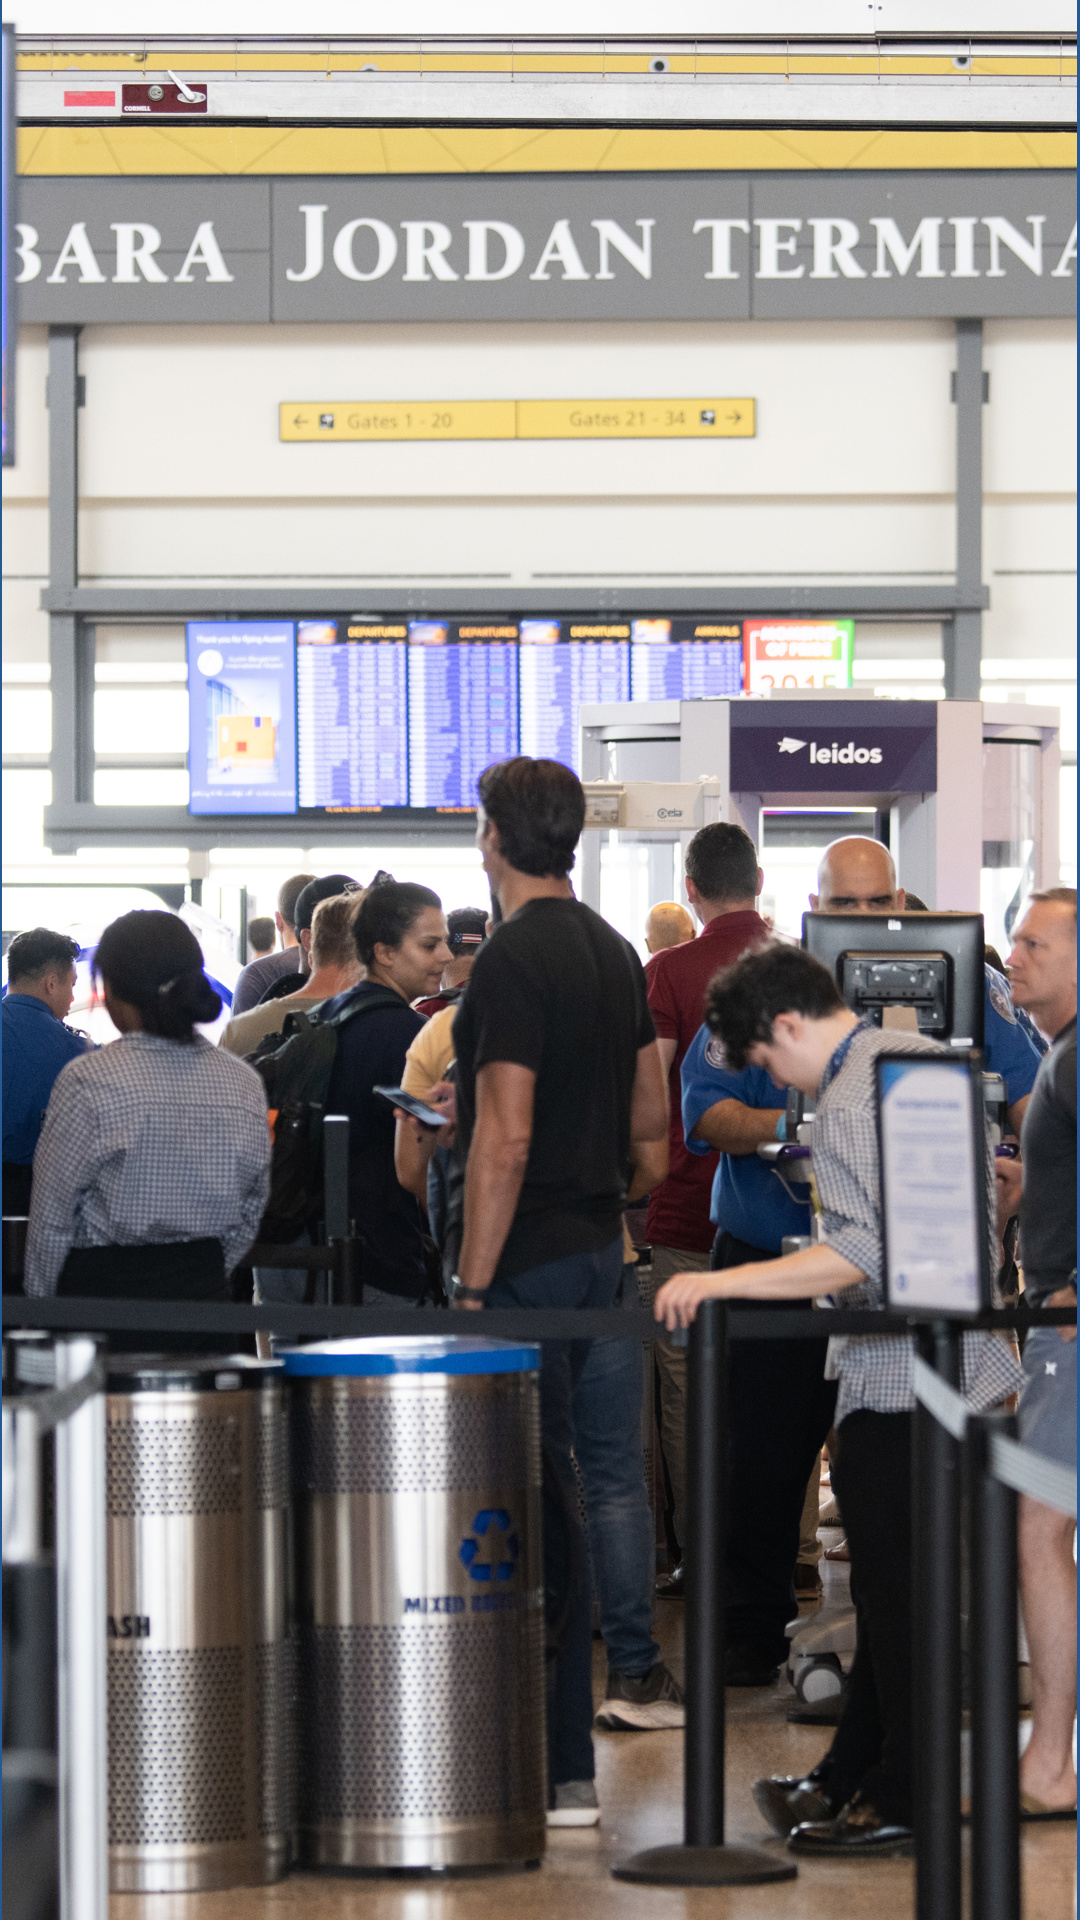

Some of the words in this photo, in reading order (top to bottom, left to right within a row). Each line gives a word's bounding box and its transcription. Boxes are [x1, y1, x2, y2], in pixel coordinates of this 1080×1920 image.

[286, 205, 655, 282] JORDAN
[347, 413, 397, 429] Gates
[405, 413, 412, 428] 1
[431, 413, 452, 428] 20
[569, 410, 619, 427] Gates
[625, 410, 646, 427] 21
[665, 409, 685, 426] 34
[347, 626, 407, 638] DEPARTURES
[458, 627, 518, 638] DEPARTURES
[570, 626, 630, 638] DEPARTURES
[694, 626, 740, 638] ARRIVALS
[810, 741, 883, 764] leidos
